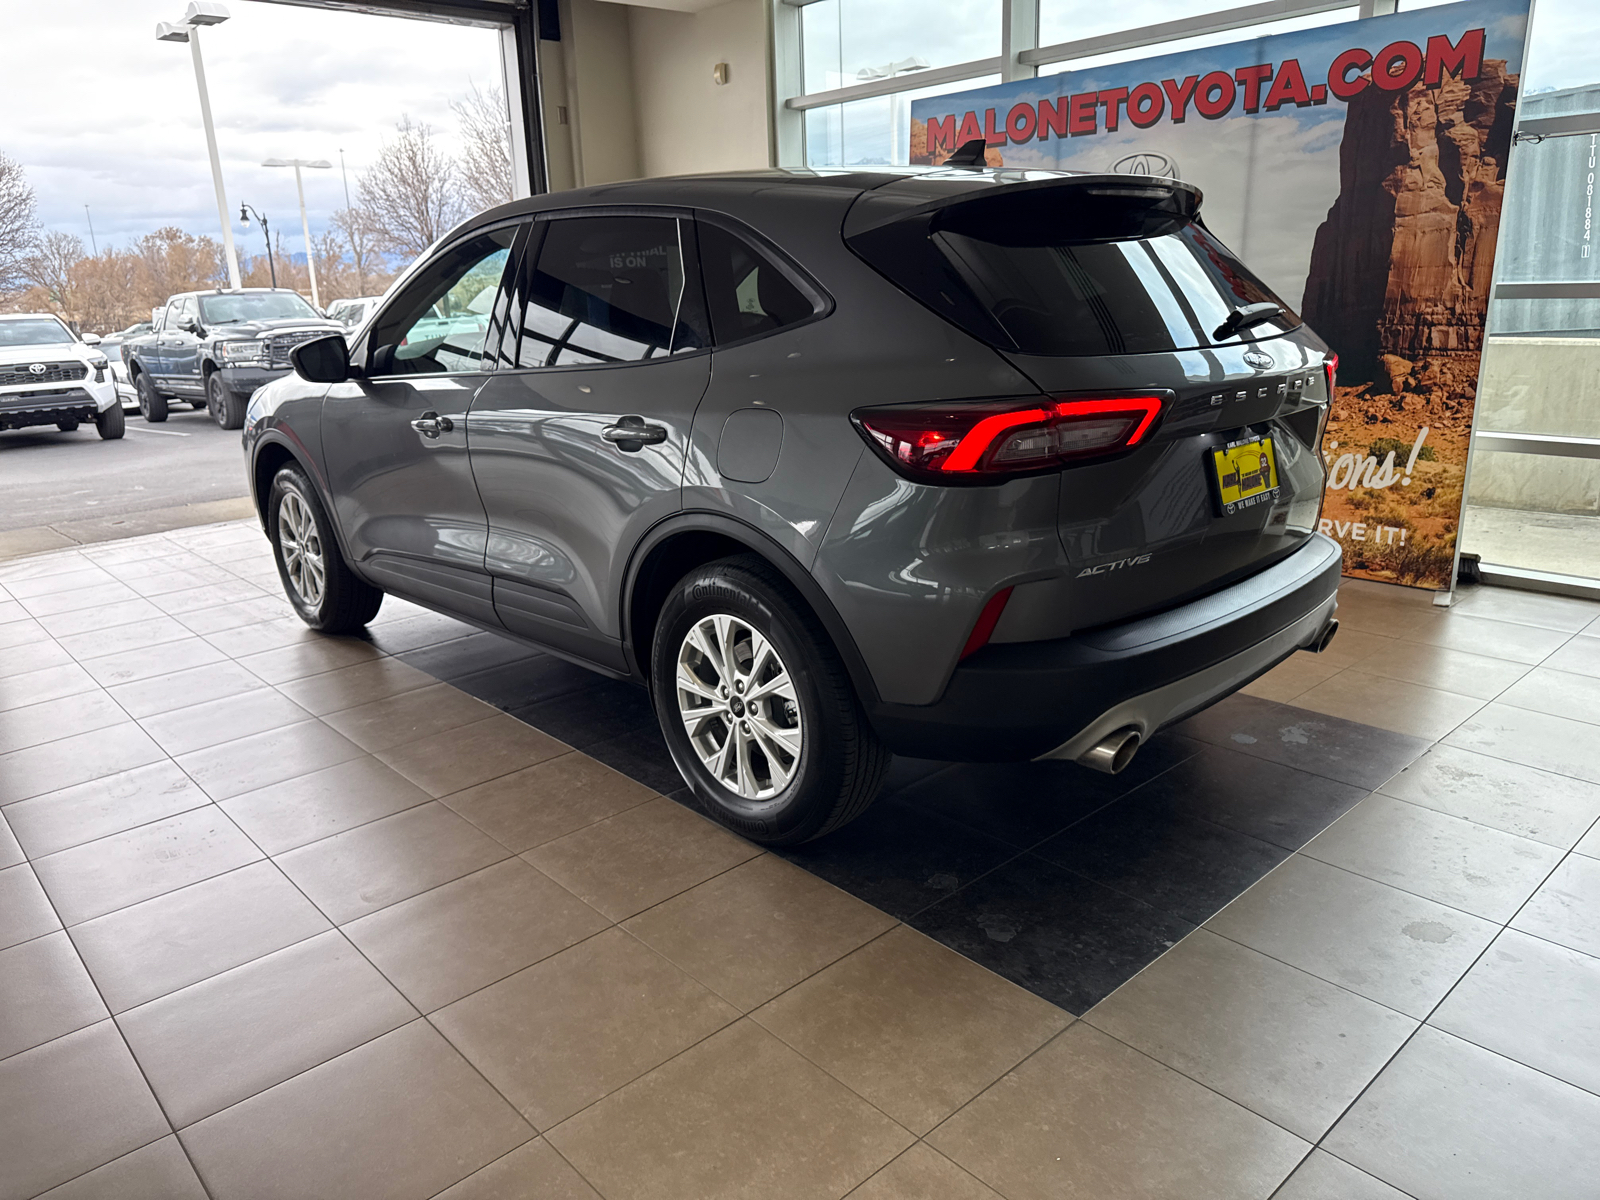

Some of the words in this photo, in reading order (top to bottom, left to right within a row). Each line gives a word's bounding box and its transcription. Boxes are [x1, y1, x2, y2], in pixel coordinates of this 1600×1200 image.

[926, 28, 1486, 154] MALONETOYOTA.COM
[1583, 172, 1595, 241] 081884
[609, 257, 623, 268] IS
[626, 256, 647, 268] ON
[1210, 376, 1315, 406] ESCAPE
[1260, 457, 1267, 467] 32
[1237, 502, 1245, 510] WE
[1245, 497, 1256, 507] MAKE
[1261, 492, 1271, 502] EASY
[1375, 525, 1407, 547] IT!
[1075, 552, 1153, 579] ACTIVE
[692, 581, 753, 608] Continental
